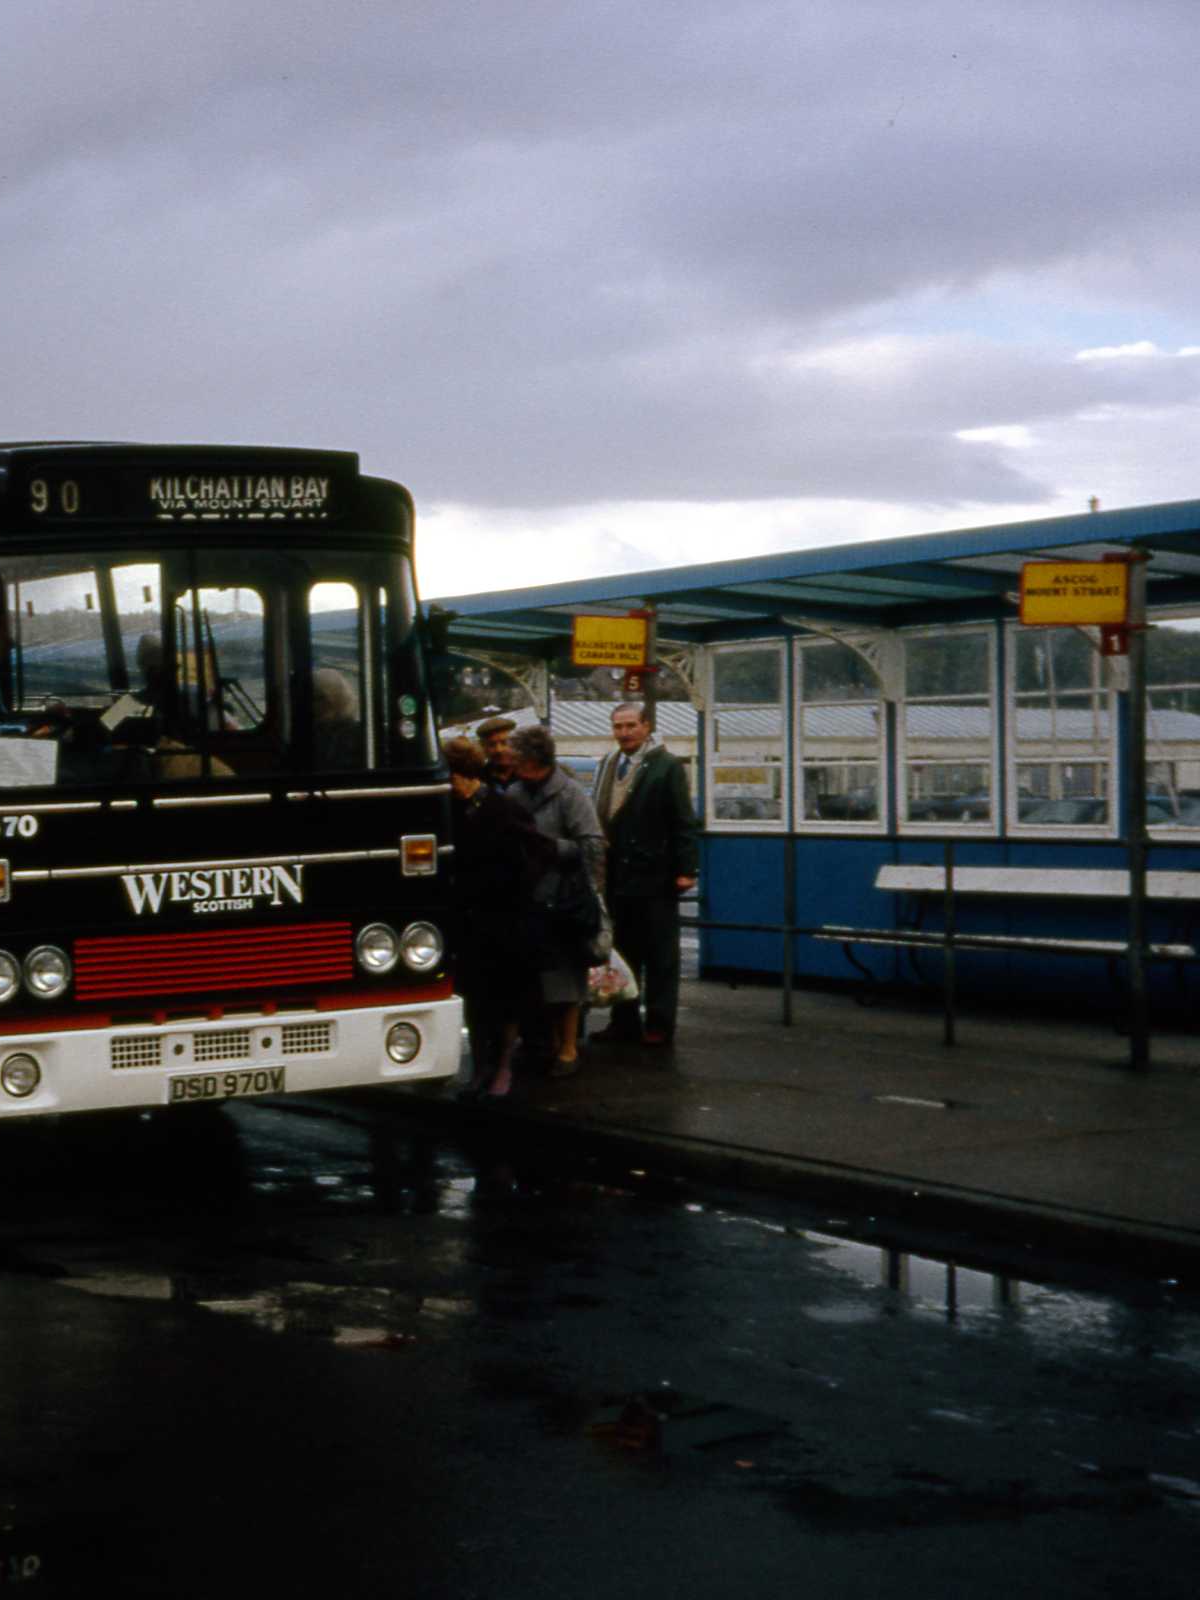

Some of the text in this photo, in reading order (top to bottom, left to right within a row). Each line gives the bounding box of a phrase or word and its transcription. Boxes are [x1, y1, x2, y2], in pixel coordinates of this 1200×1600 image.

[151, 476, 329, 500] KILCHATTAN BAY
[160, 498, 324, 510] VIA MOUNT STUART
[1110, 634, 1119, 652] 1
[628, 675, 640, 691] 5
[121, 864, 304, 915] WESTERN
[192, 898, 253, 913] SCOTTISH
[172, 1069, 283, 1100] DSD 970V
